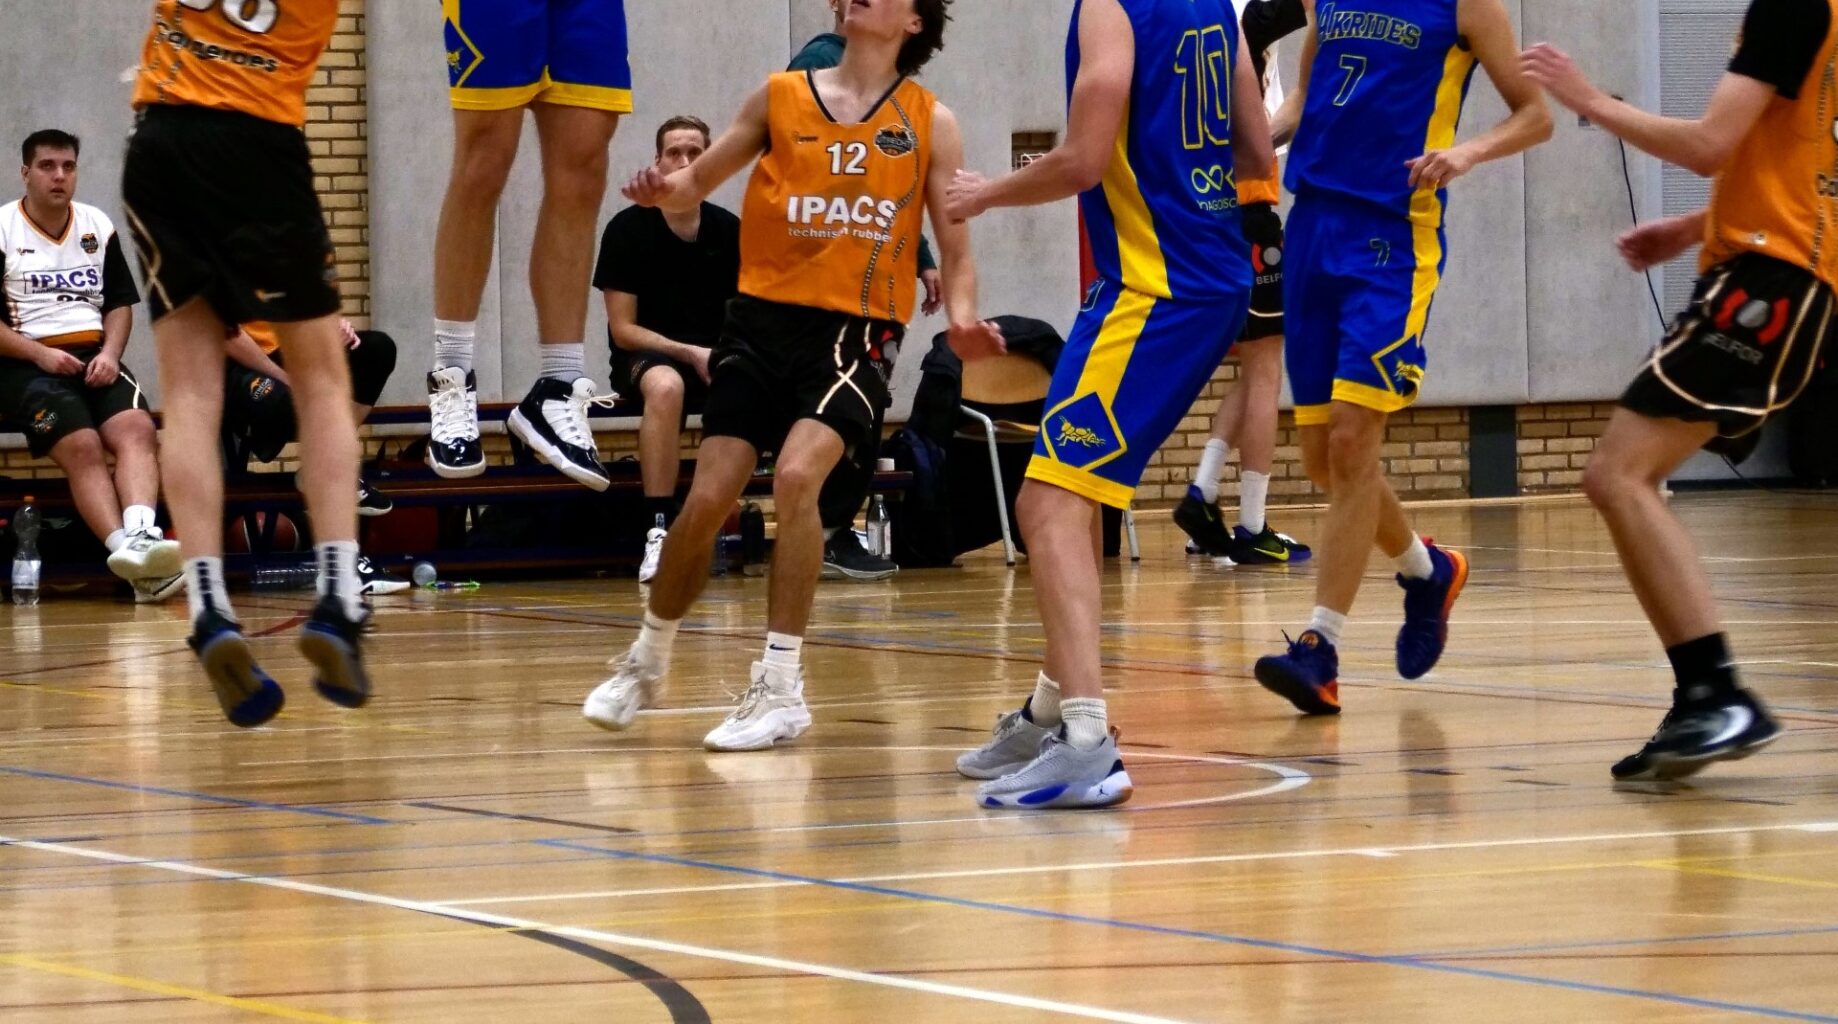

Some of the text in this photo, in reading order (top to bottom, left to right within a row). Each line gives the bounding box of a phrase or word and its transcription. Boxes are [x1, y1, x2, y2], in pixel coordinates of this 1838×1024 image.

[1318, 1, 1422, 50] AKRIDES
[1173, 24, 1231, 150] 10
[1332, 54, 1367, 106] 7
[826, 140, 868, 175] 12
[787, 195, 898, 228] IPACS
[31, 268, 98, 288] IPACS
[1256, 273, 1282, 285] BELF
